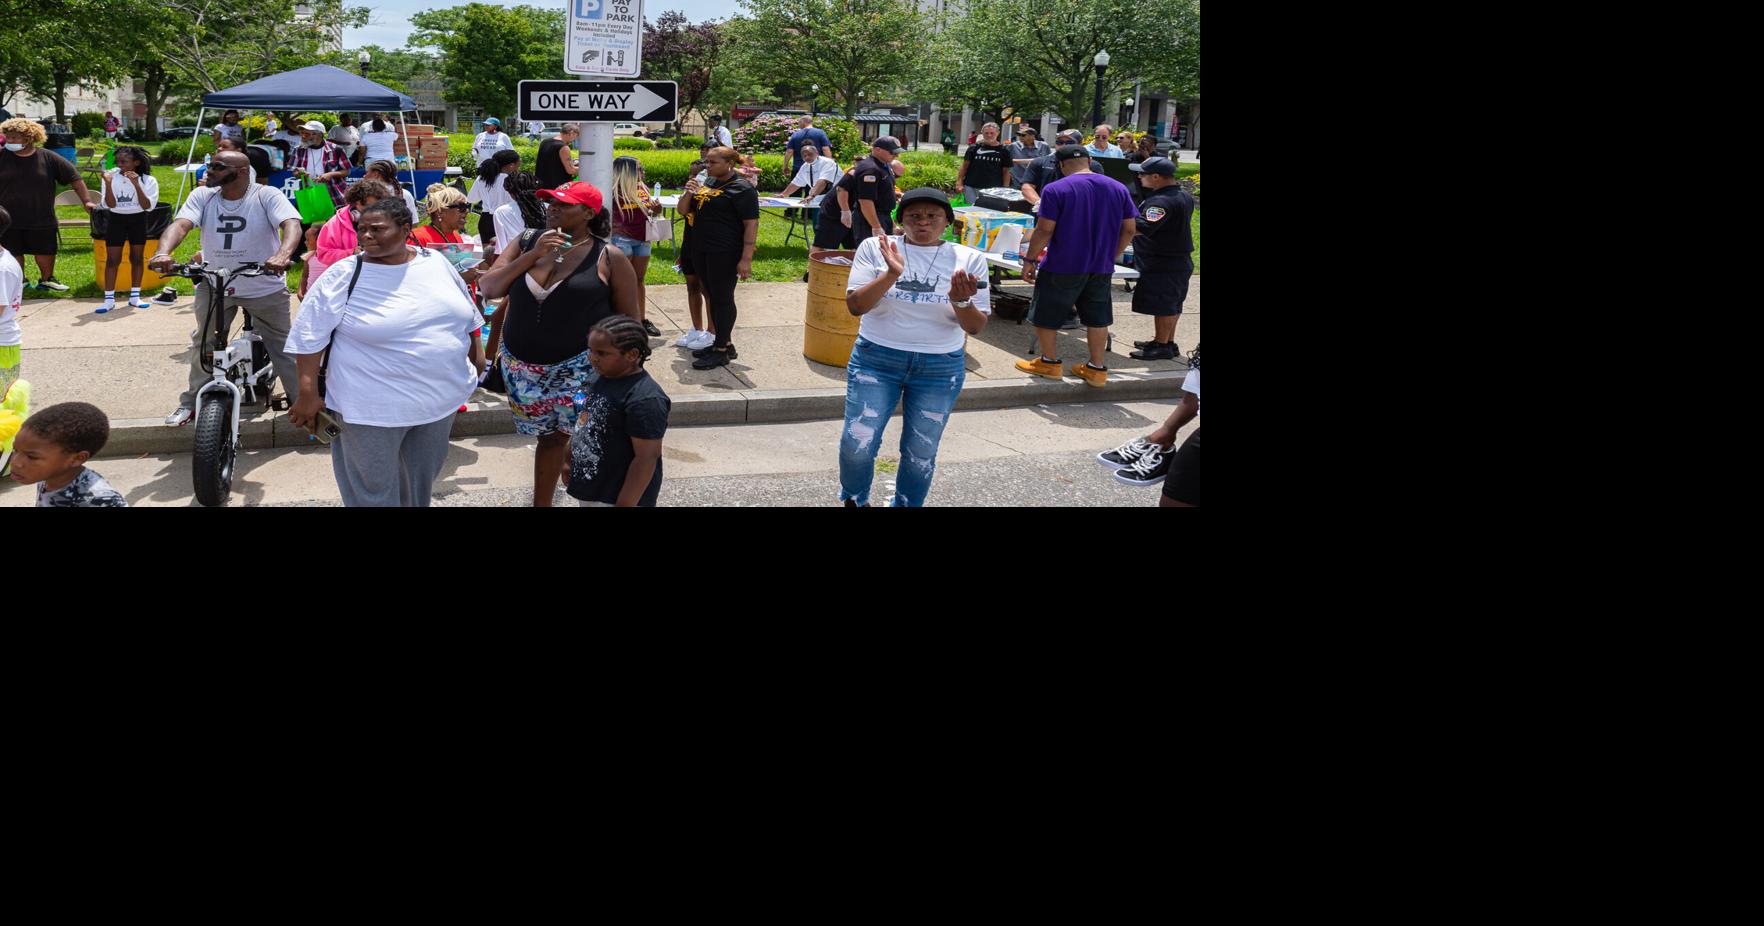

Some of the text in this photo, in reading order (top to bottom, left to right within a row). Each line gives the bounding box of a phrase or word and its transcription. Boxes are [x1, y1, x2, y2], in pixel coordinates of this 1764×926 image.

[606, 13, 635, 22] PARK
[538, 93, 631, 109] ONE WAY
